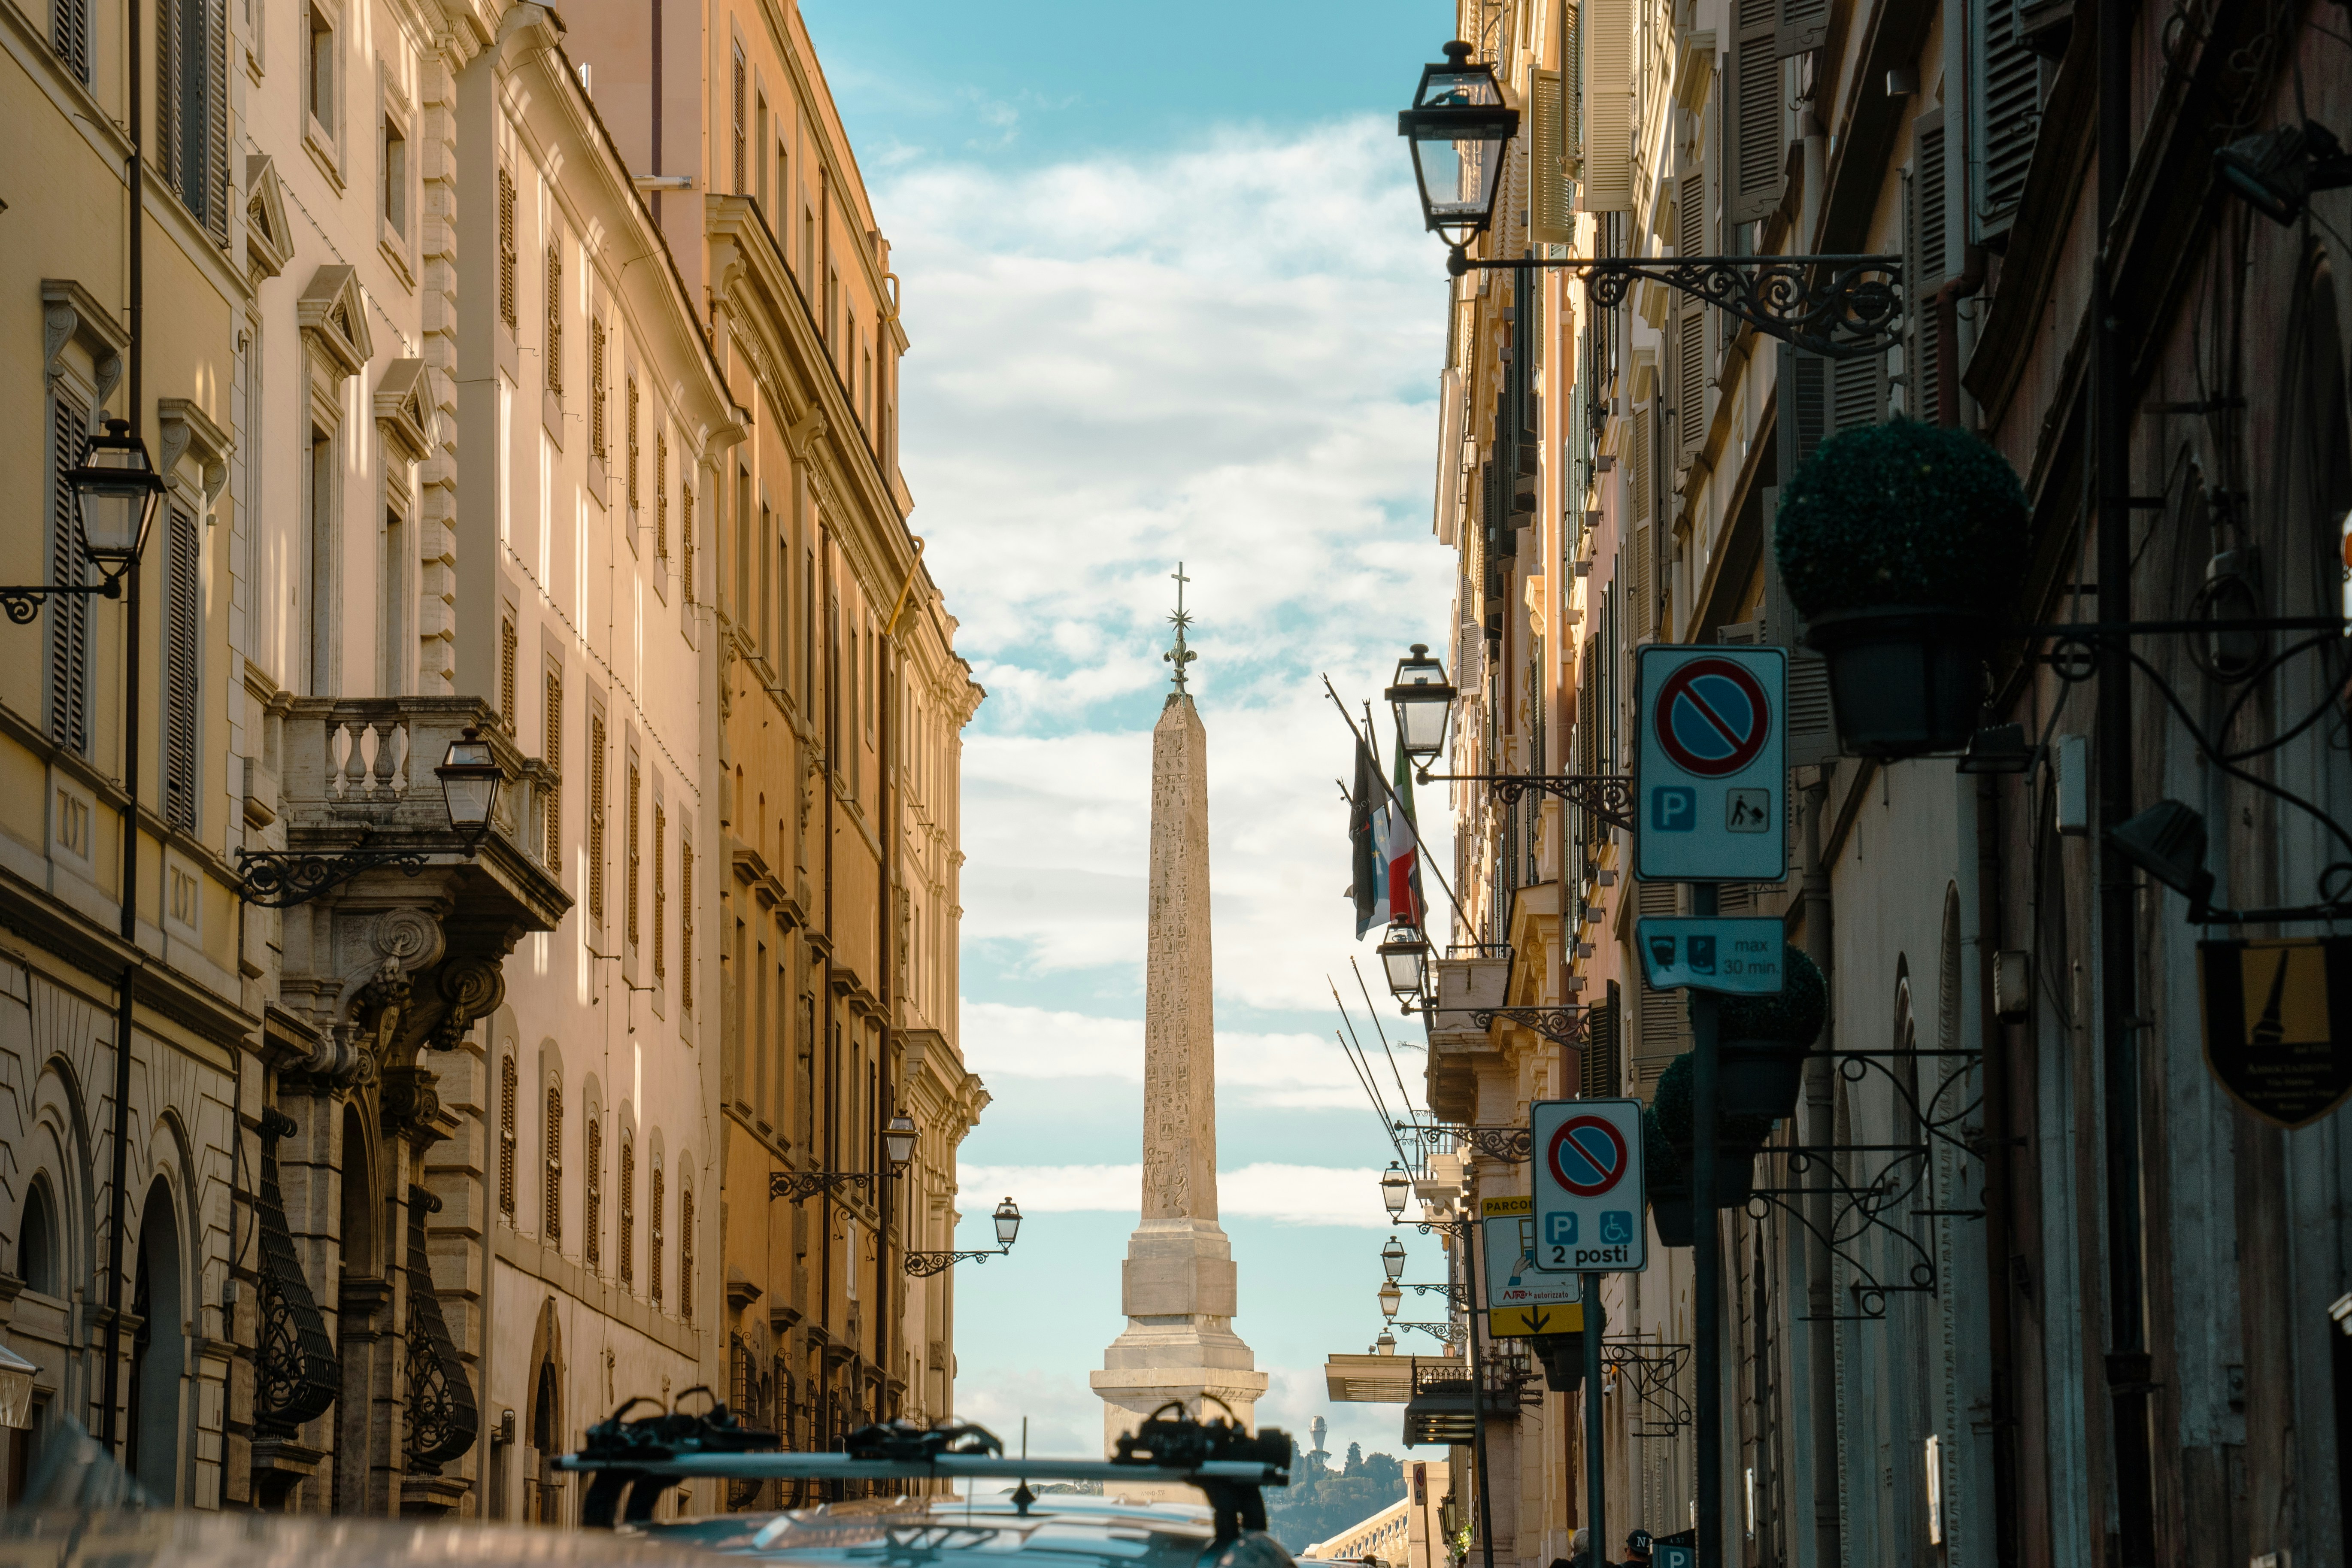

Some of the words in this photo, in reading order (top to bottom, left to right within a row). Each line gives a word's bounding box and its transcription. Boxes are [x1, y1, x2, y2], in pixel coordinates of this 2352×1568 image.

[1663, 792, 1687, 826] P
[1735, 940, 1768, 952] max
[1724, 958, 1743, 974] 30
[1553, 1216, 1572, 1240] P
[1552, 1245, 1566, 1263] 2
[1576, 1244, 1628, 1267] posti
[1534, 1291, 1569, 1299] autorizzato
[1670, 1551, 1685, 1568] P
